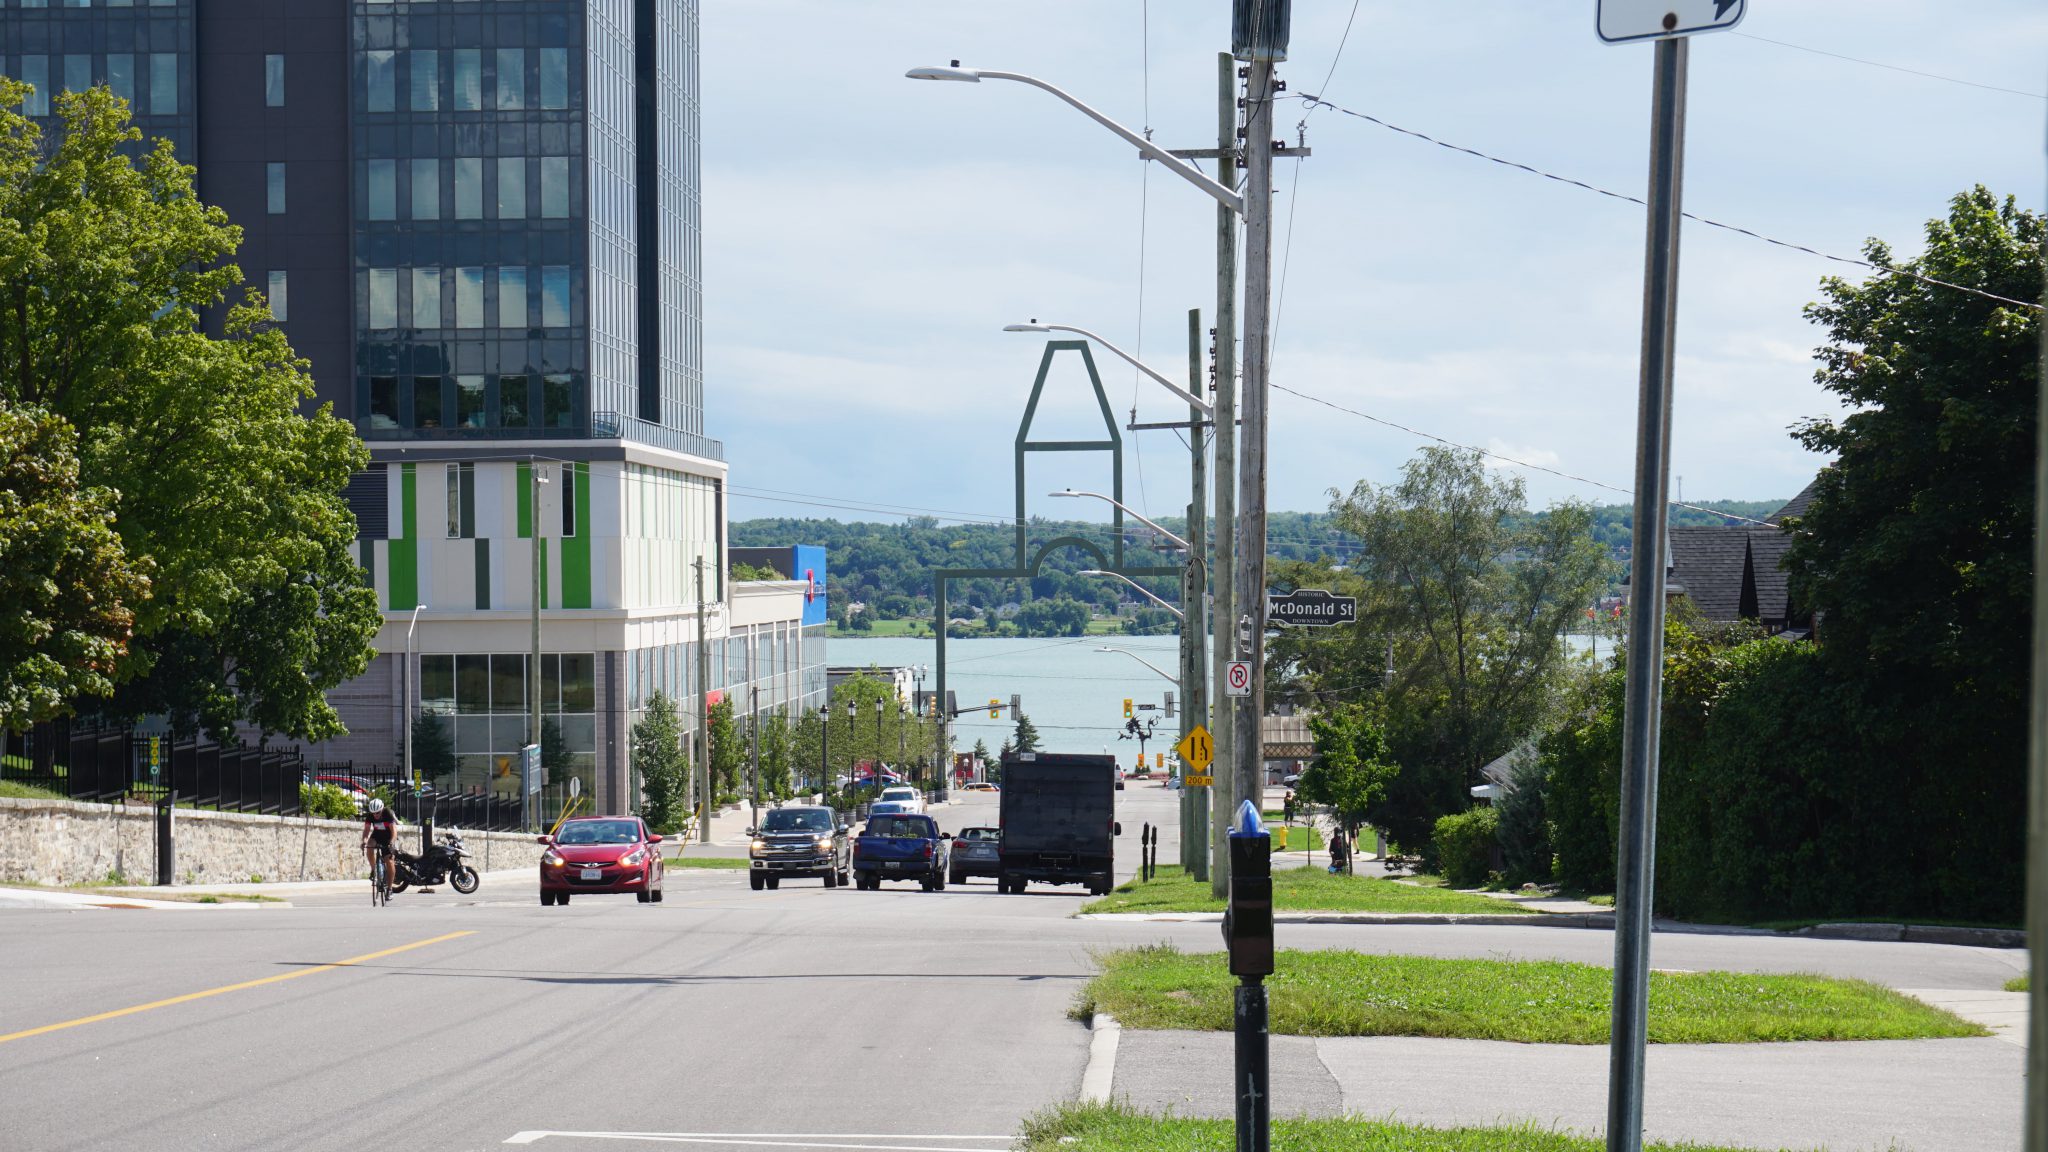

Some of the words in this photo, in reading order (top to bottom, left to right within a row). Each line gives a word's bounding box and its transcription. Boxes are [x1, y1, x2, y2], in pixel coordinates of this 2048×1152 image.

[1270, 602, 1334, 615] McDonald
[1340, 603, 1353, 616] St
[1187, 776, 1203, 784] 200
